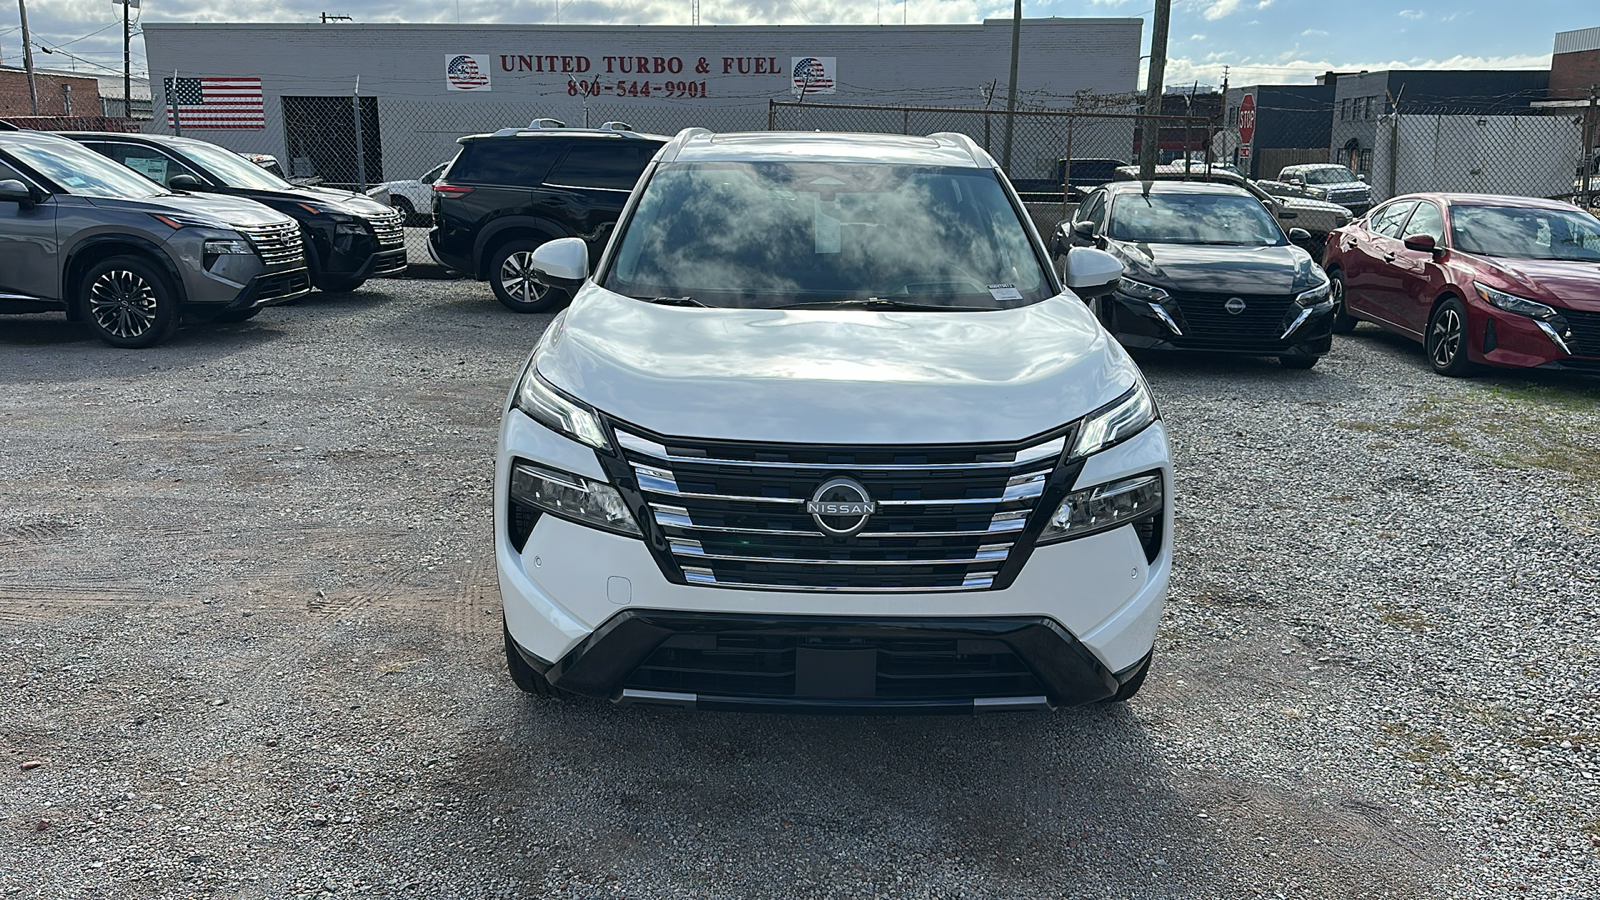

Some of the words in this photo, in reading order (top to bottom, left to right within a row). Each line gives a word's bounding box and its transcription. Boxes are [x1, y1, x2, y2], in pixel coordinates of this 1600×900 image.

[500, 54, 591, 73] UNITED
[603, 56, 683, 74] TURBO
[695, 56, 710, 74] &
[722, 57, 782, 74] FUEL
[1240, 110, 1255, 129] STOP
[808, 503, 874, 514] NISSAN
